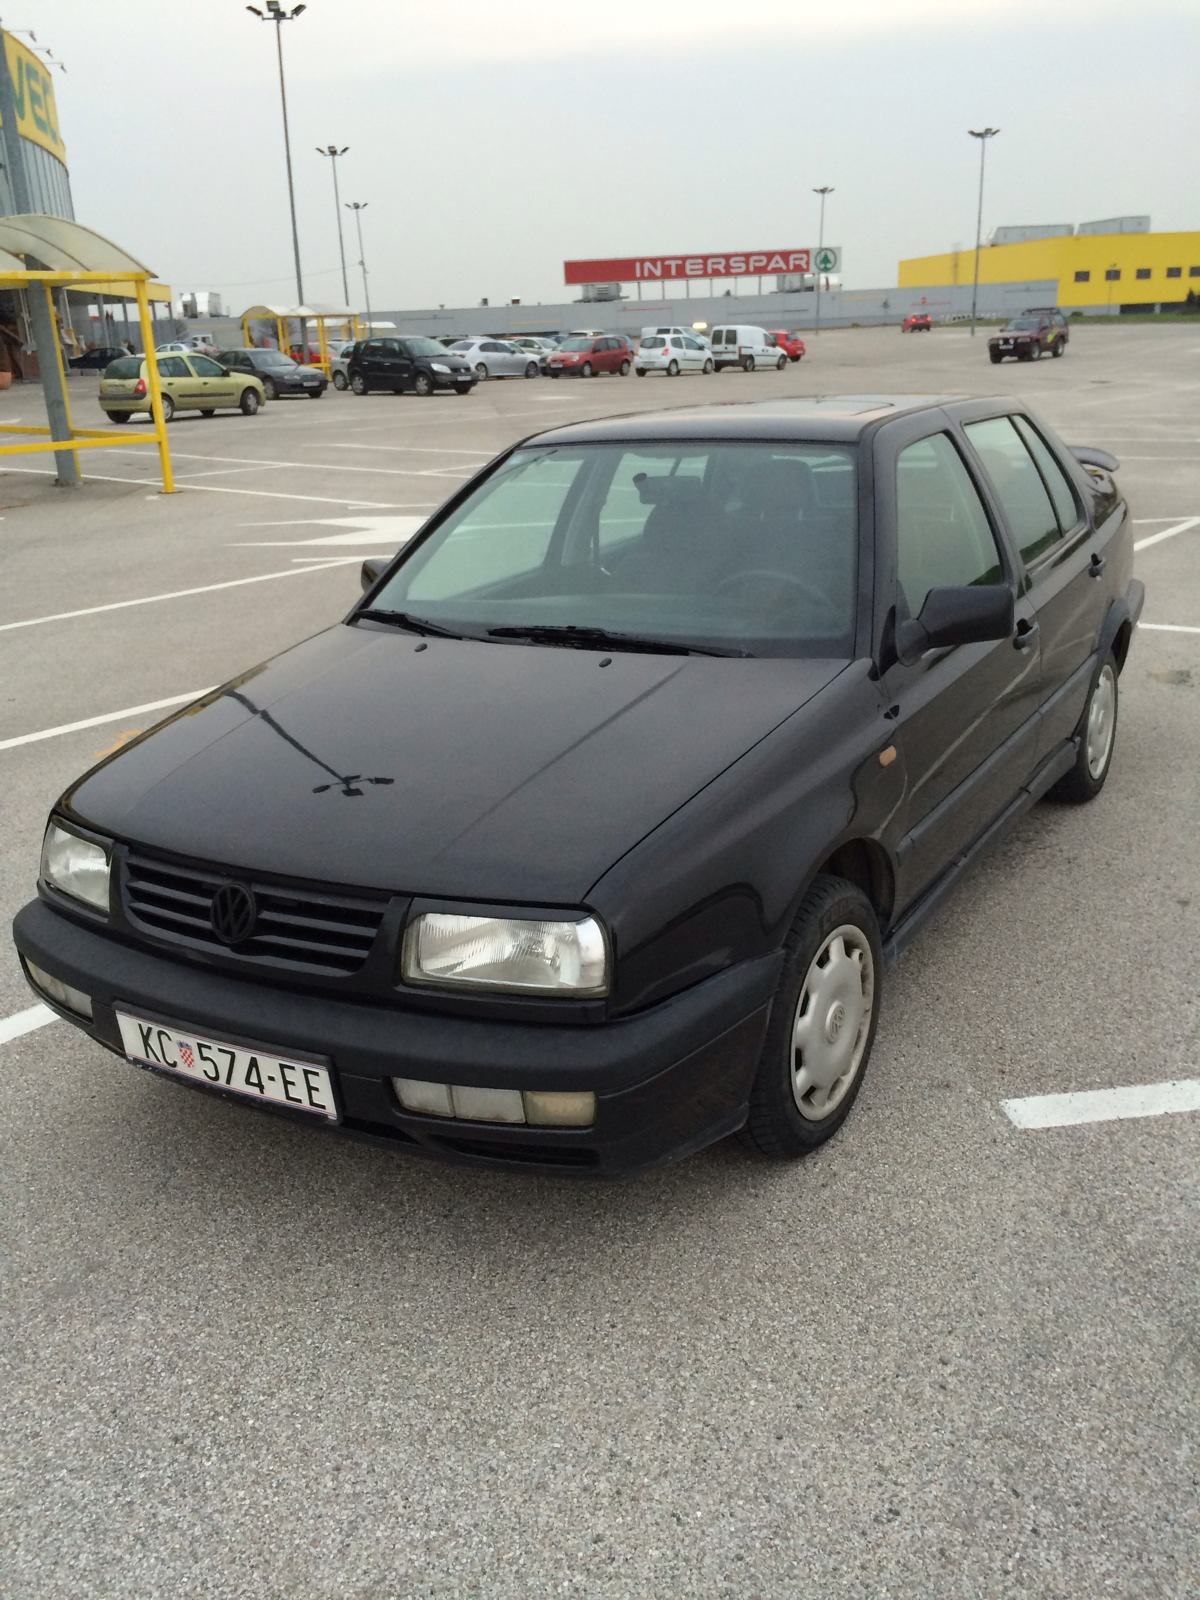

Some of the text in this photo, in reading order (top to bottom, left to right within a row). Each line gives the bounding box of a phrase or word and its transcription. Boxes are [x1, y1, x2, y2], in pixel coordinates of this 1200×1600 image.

[635, 253, 808, 277] INTERSPAR
[138, 1022, 327, 1110] KC 574-EE
